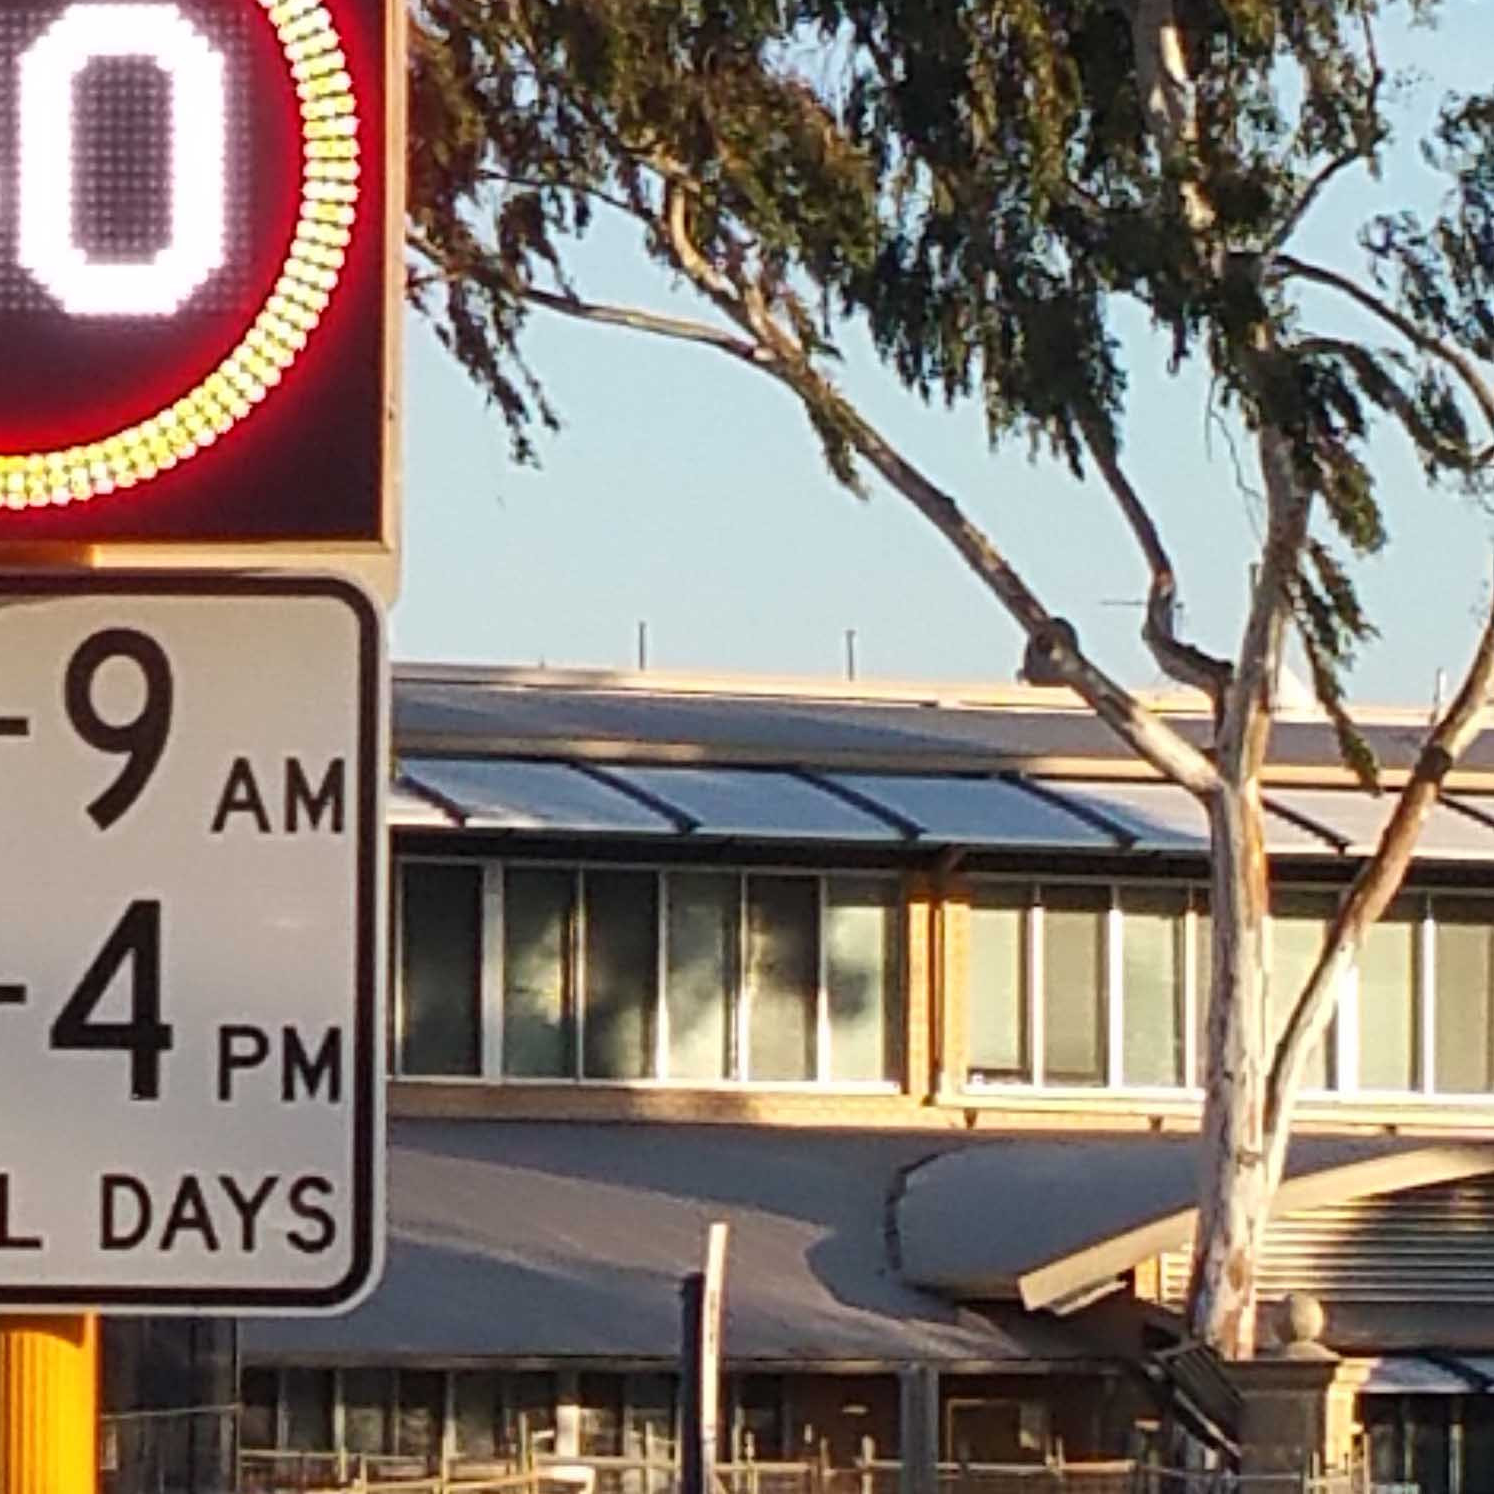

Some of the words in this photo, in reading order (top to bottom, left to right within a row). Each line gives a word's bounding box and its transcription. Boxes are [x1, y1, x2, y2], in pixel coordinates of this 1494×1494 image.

[211, 757, 346, 834] AM
[217, 1026, 343, 1104] PM
[99, 1175, 338, 1254] DAYS
